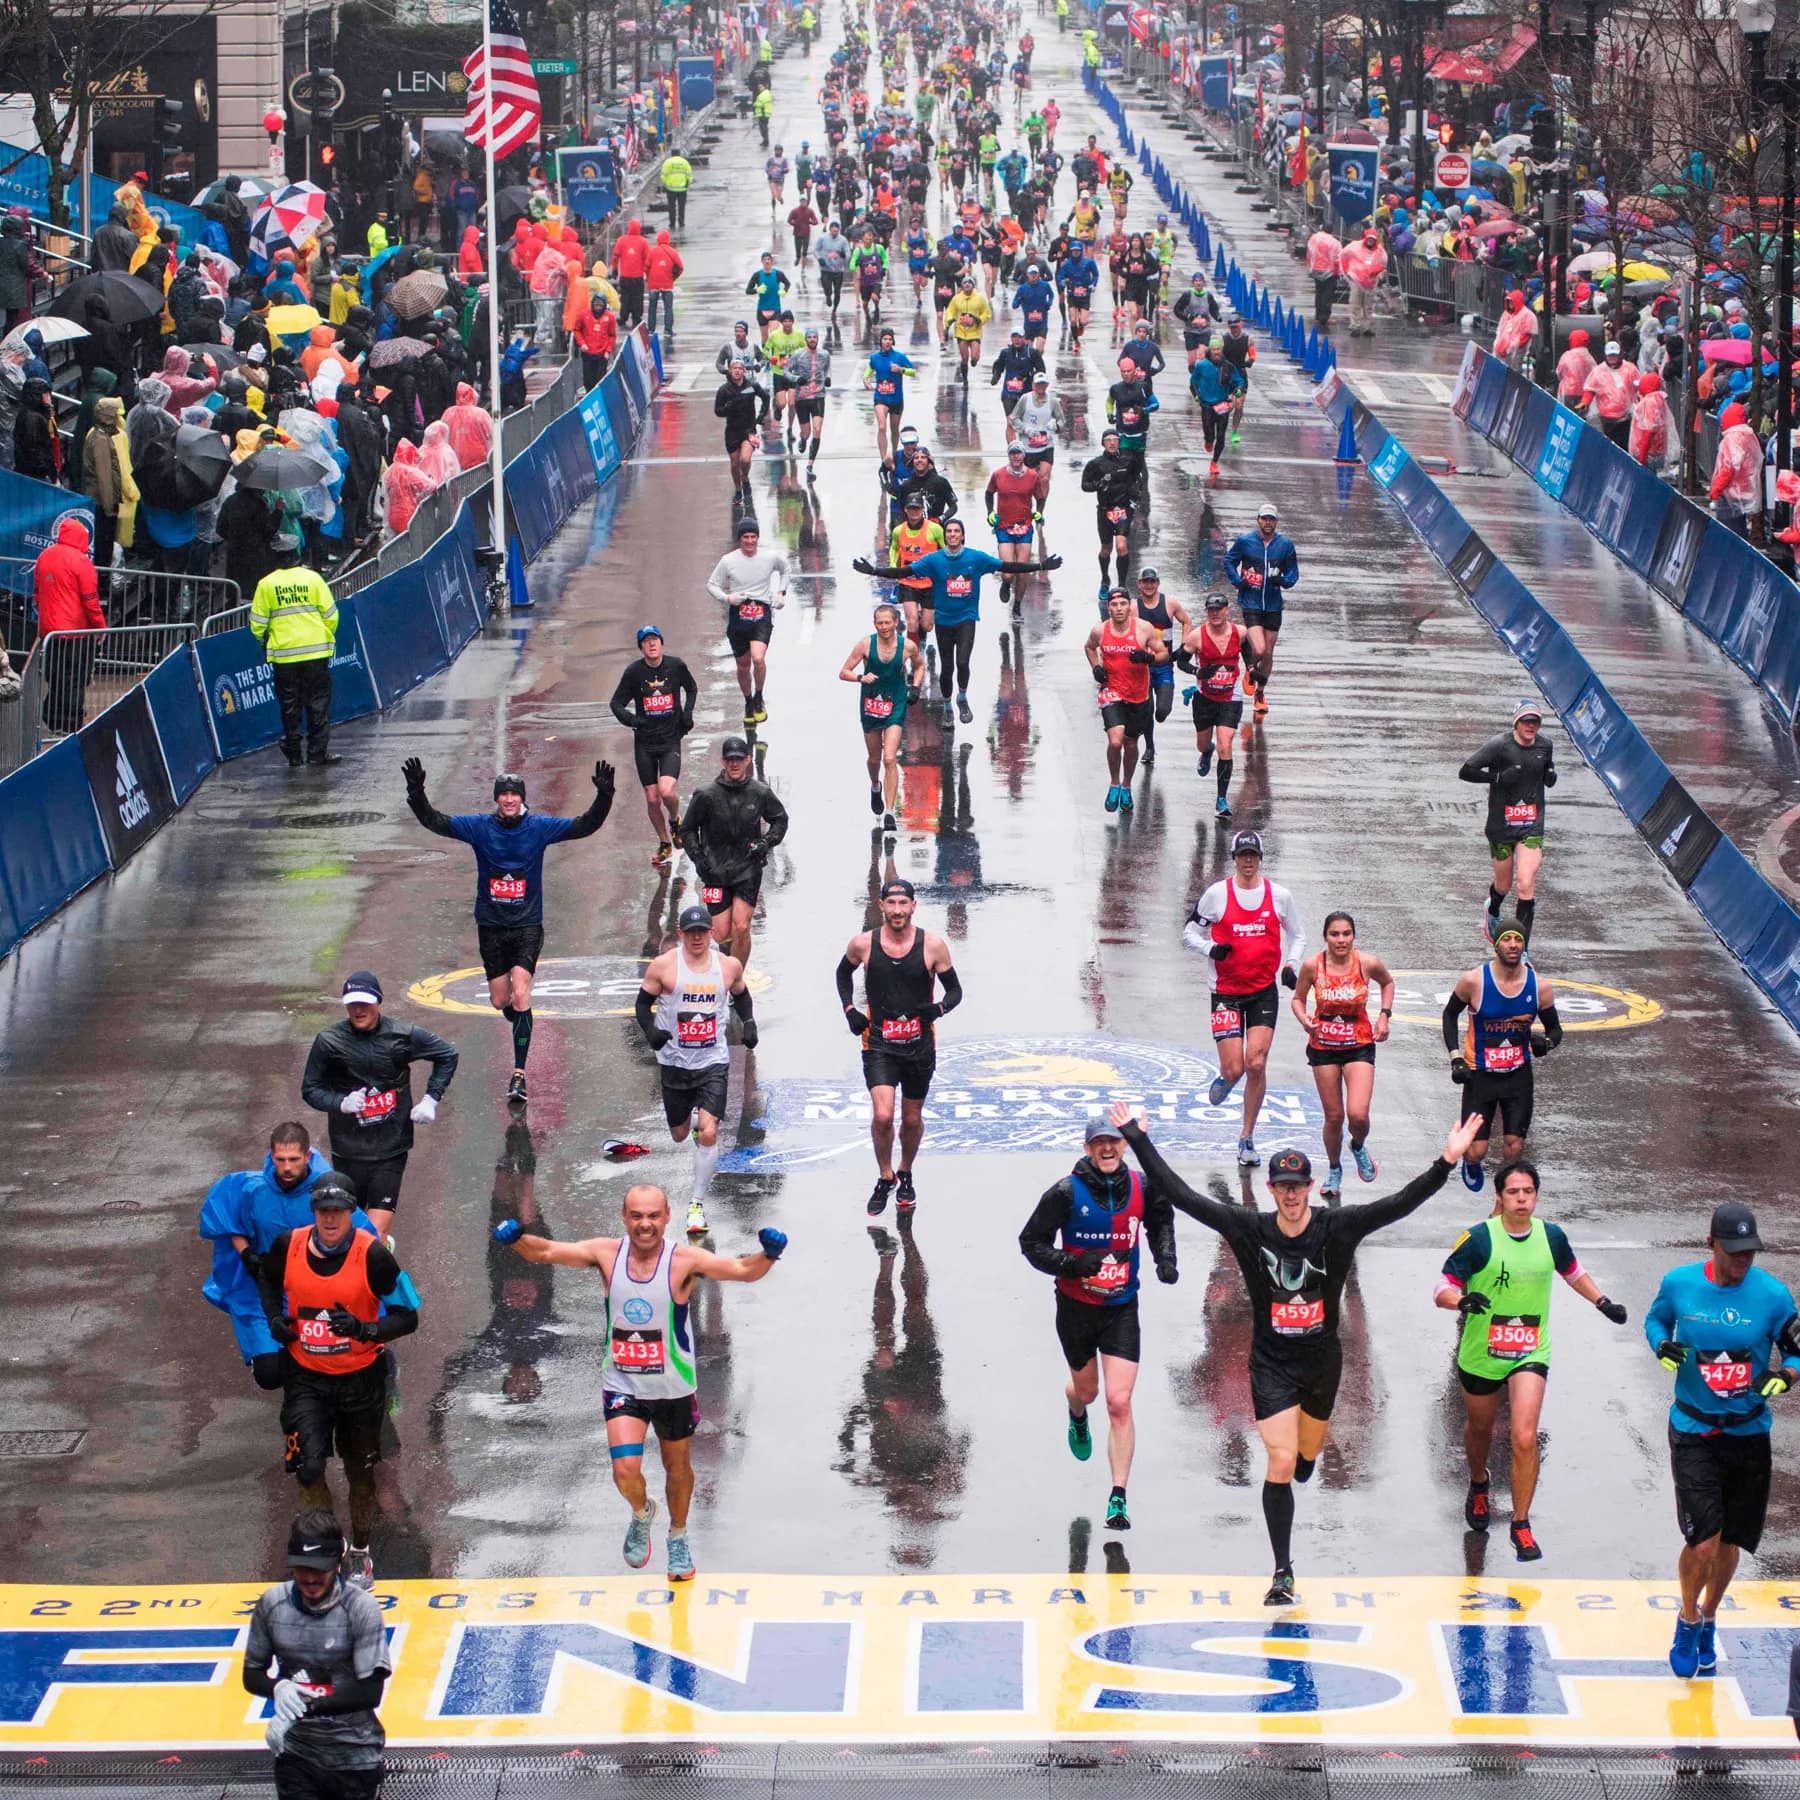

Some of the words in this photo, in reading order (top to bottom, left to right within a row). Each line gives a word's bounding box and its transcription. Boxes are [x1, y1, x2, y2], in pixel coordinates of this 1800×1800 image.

[537, 63, 564, 73] EXETER
[274, 584, 309, 595] Boston
[276, 593, 310, 606] Police
[235, 668, 256, 688] THE
[645, 695, 671, 707] 3809
[866, 699, 890, 712] 5196
[119, 788, 151, 830] adidas
[1507, 805, 1534, 817] 3068
[682, 993, 716, 1003] REAM
[681, 1021, 713, 1035] 3628
[887, 1019, 919, 1034] 3442
[1321, 1022, 1354, 1036] 6625
[1488, 1047, 1521, 1061] 6489
[1001, 1089, 1302, 1109] BOSTON
[1276, 1301, 1320, 1319] 4597
[1492, 1326, 1535, 1343] 3506
[616, 1341, 659, 1358] 2133
[1701, 1363, 1747, 1382] 5479
